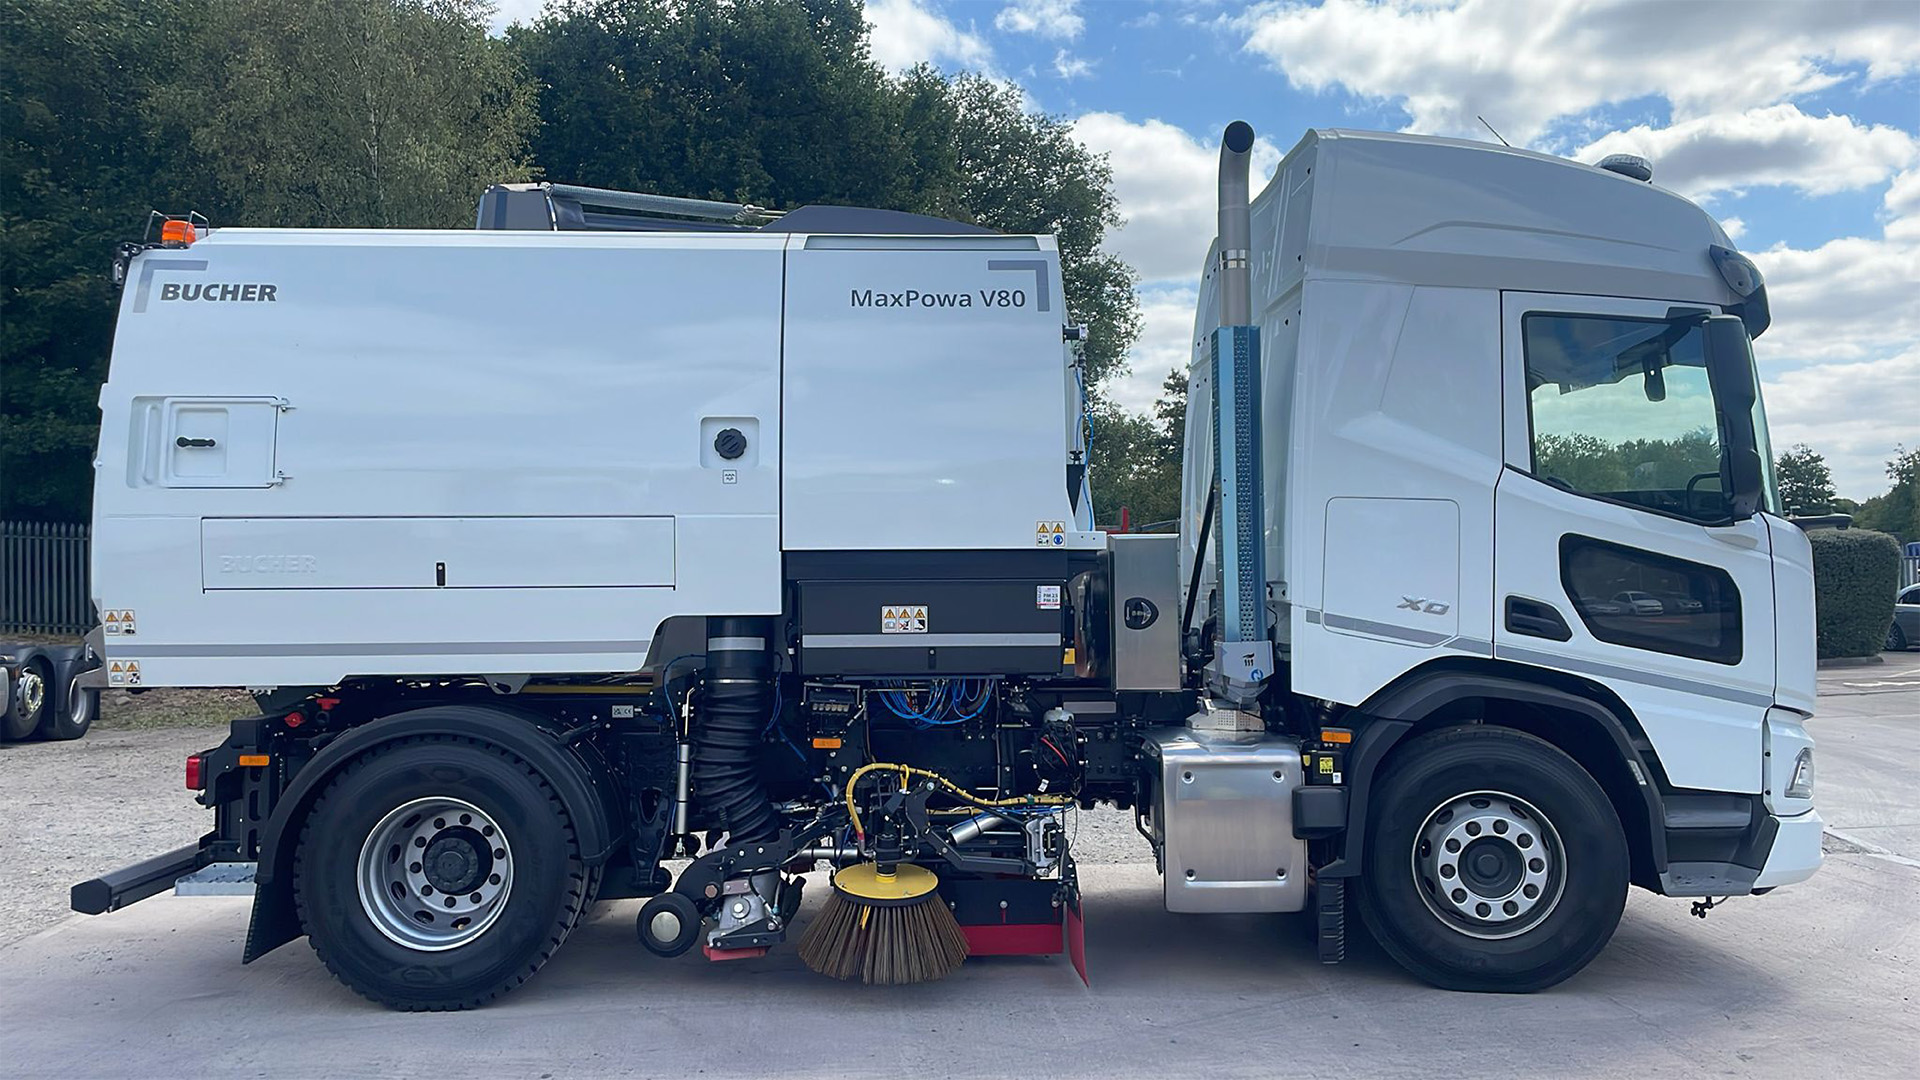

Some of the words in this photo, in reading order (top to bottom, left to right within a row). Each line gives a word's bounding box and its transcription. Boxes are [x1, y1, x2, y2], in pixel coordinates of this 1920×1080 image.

[160, 283, 278, 302] BUCHER
[850, 289, 972, 308] MaxPowa
[979, 289, 1026, 308] V80
[219, 555, 317, 573] BUCHER
